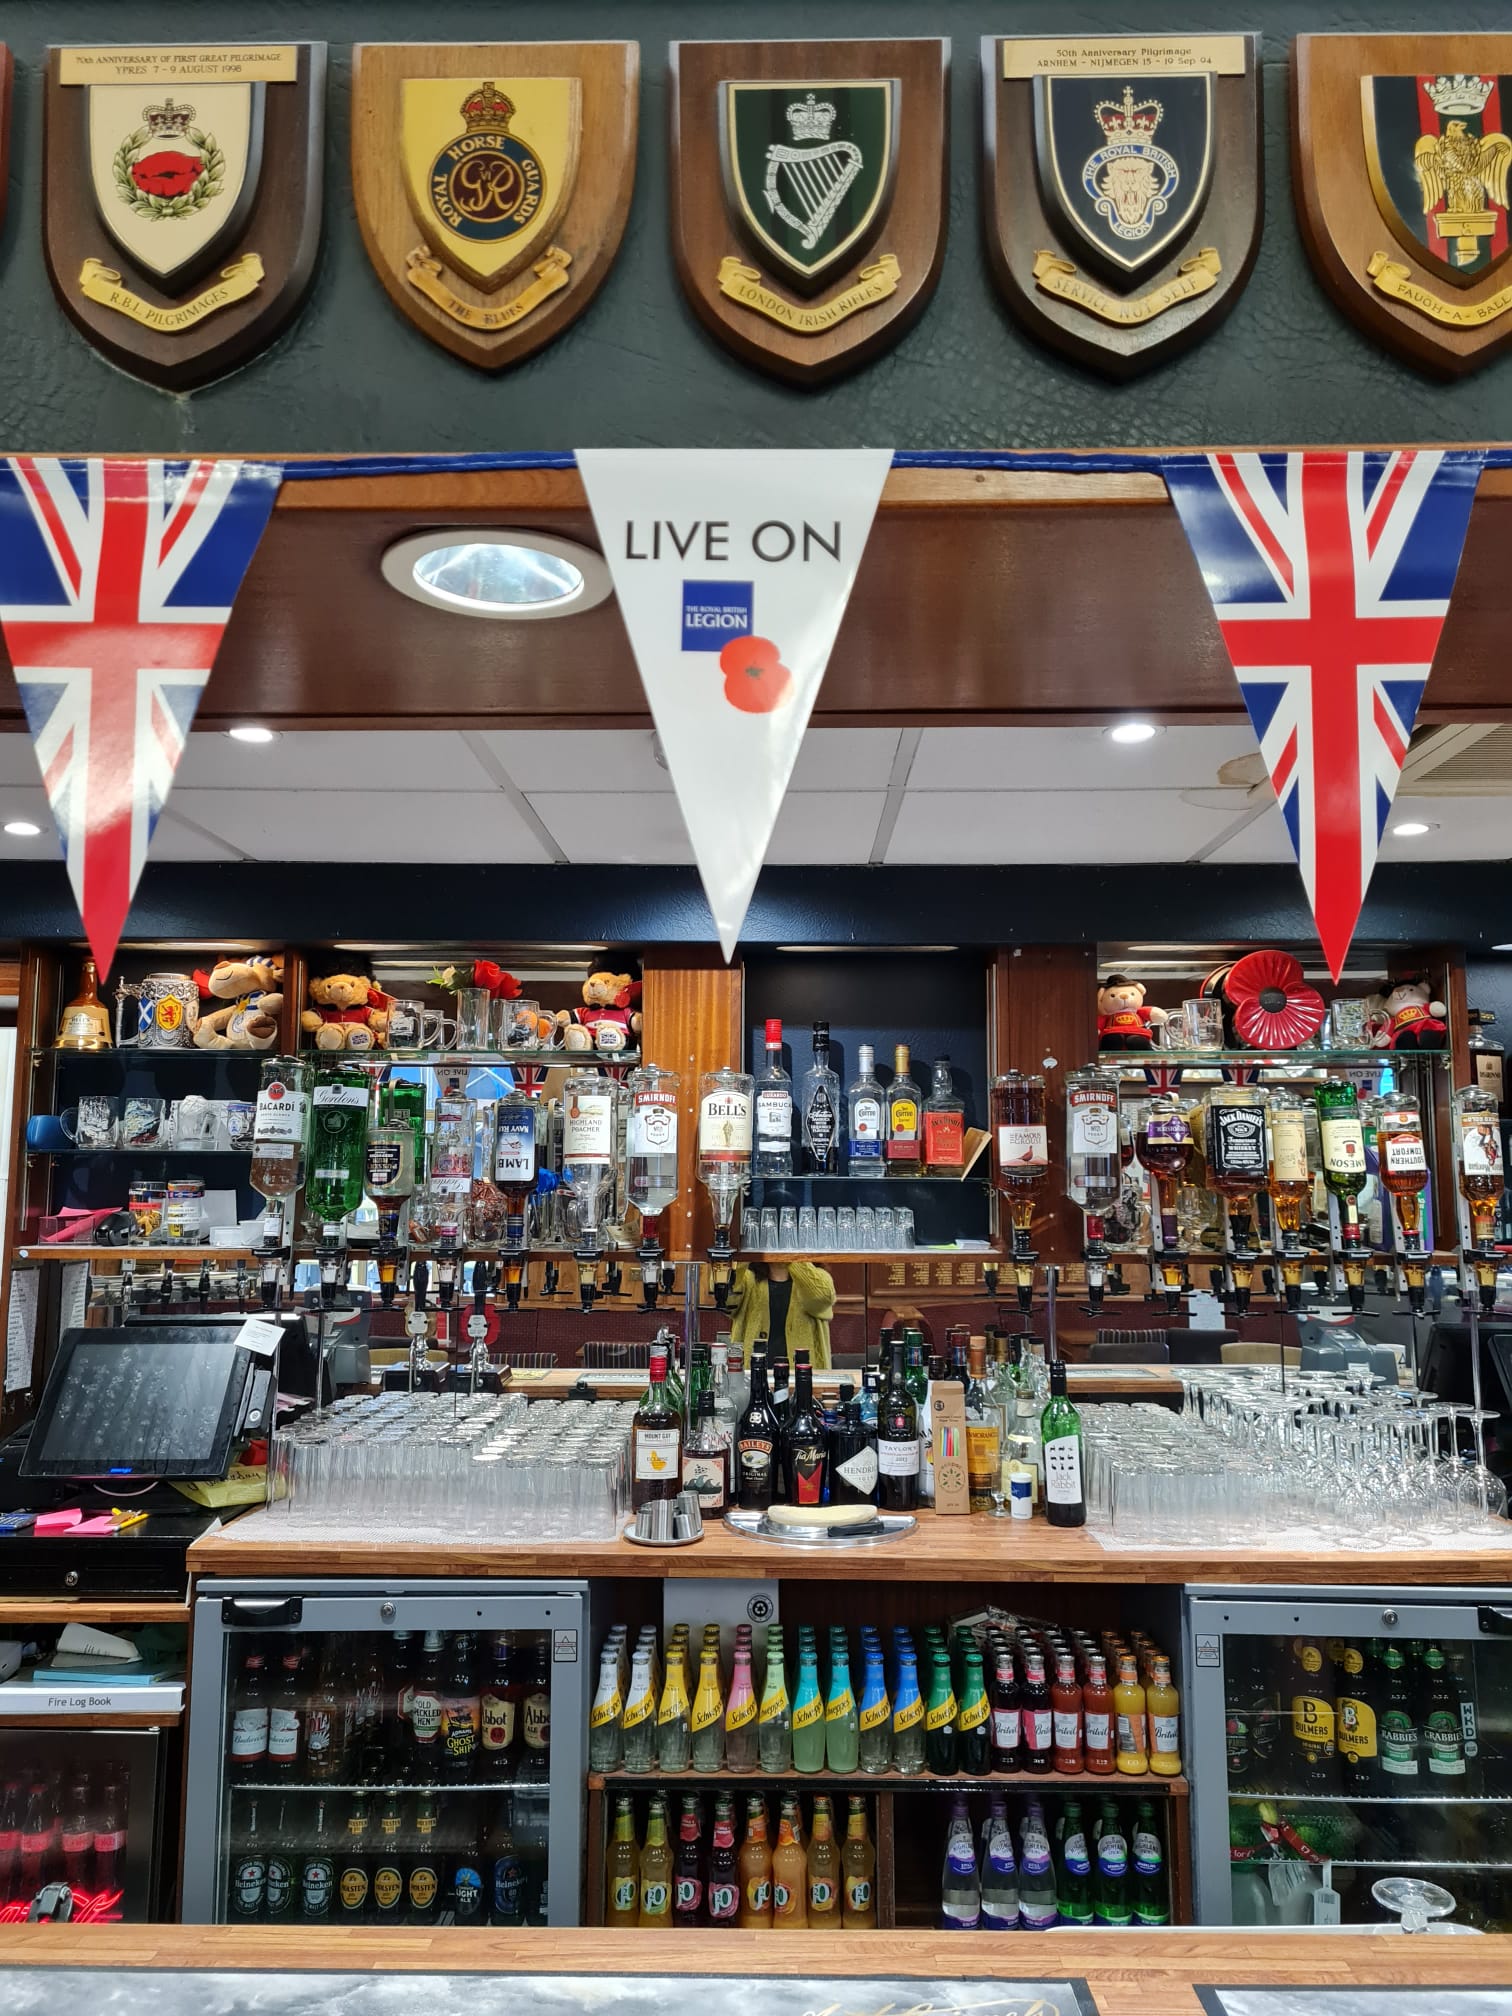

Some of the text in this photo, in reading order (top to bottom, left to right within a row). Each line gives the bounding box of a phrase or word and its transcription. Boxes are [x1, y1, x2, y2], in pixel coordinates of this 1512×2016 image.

[200, 54, 228, 62] GREAT
[1081, 49, 1136, 58] Anniversary
[1141, 48, 1192, 56] Pilgrimage
[180, 65, 218, 73] AUGUST
[1090, 58, 1139, 67] NIJMEGEN
[1178, 58, 1195, 66] Sep
[1084, 145, 1176, 179] THE ROYAL BRITISH
[432, 135, 540, 227] ROYAL HORSE GUARDS
[1113, 221, 1151, 238] LEGION
[1053, 278, 1198, 319] SERVICE NOT SELF
[145, 287, 229, 326] PILGRIMAGES
[738, 285, 883, 326] LONDON IRISH RIFLES
[626, 519, 841, 562] LIVE ON
[686, 613, 748, 628] LEGION
[638, 1094, 676, 1104] SMIRNOFF
[1074, 1093, 1114, 1103] SMIRNOFF
[708, 1103, 747, 1116] BELL'S
[1219, 1113, 1236, 1127] JACK
[1014, 1131, 1041, 1139] FAMOUS
[1392, 1147, 1421, 1155] COMFORT
[739, 1441, 771, 1450] BAILEYS
[804, 1447, 827, 1462] Maria
[843, 1466, 876, 1475] HENDRI
[48, 1697, 112, 1708] Fire Log Book
[526, 1706, 550, 1724] Abbo
[1463, 1705, 1475, 1737] WKD
[1296, 1722, 1328, 1735] BULMERS
[447, 1735, 475, 1748] GHOST
[1339, 1731, 1369, 1744] BULMERS
[454, 1744, 472, 1755] SHIP
